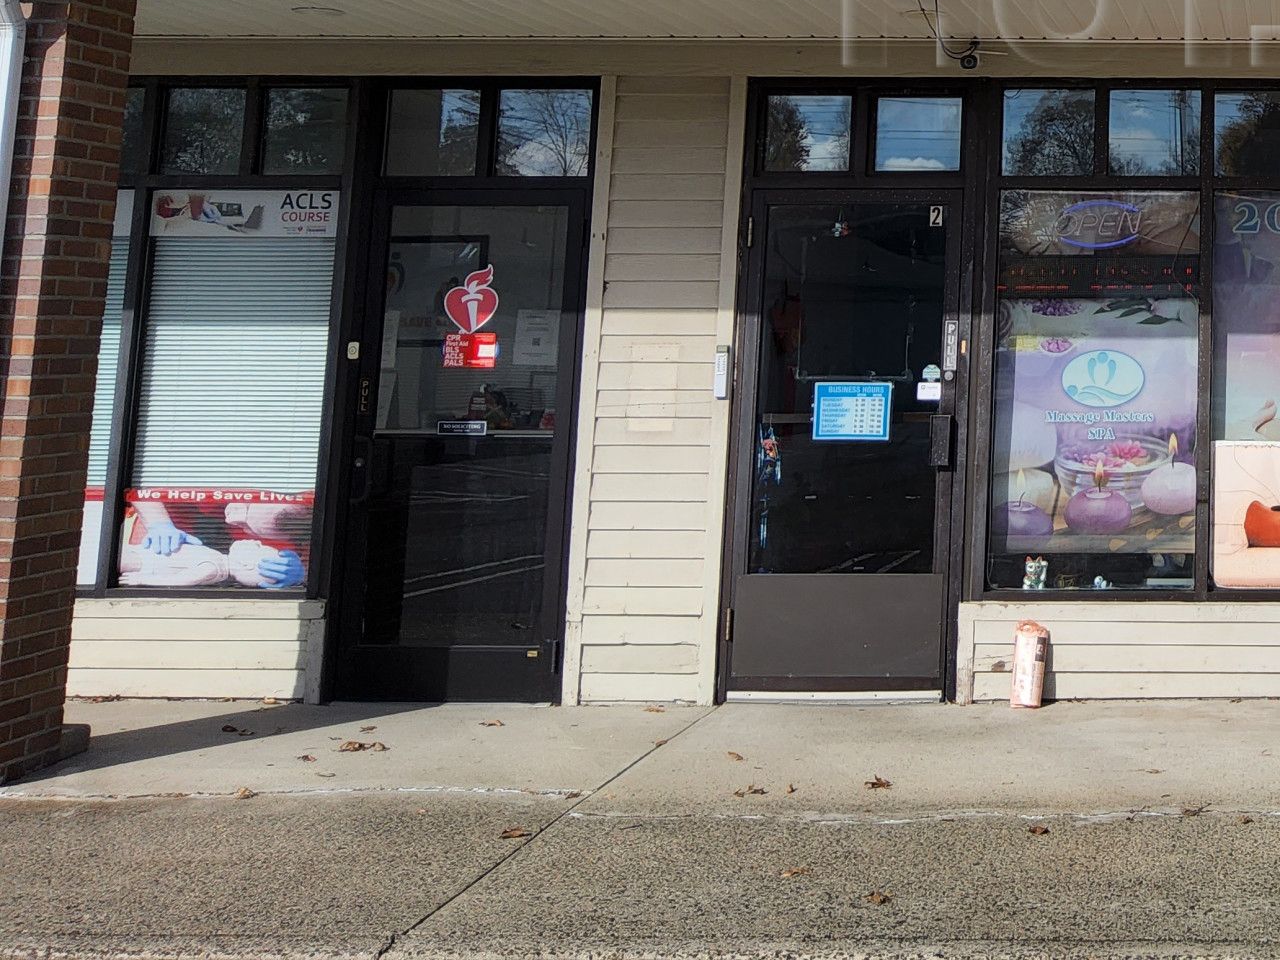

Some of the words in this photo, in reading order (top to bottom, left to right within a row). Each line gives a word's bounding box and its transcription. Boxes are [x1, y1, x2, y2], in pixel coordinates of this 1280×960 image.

[280, 193, 332, 209] ACLS
[281, 211, 331, 222] COURSE
[931, 207, 941, 225] 2
[1054, 211, 1144, 237] OPEN
[945, 323, 956, 369] PULL
[360, 380, 369, 411] PULL
[828, 386, 861, 394] BUSINESS
[862, 386, 885, 394] HOURS
[1044, 410, 1101, 425] Massage
[1103, 410, 1154, 423] Masters
[1087, 427, 1116, 440] SPA
[137, 489, 161, 499] We
[167, 490, 206, 501] Help
[212, 491, 254, 501] Save
